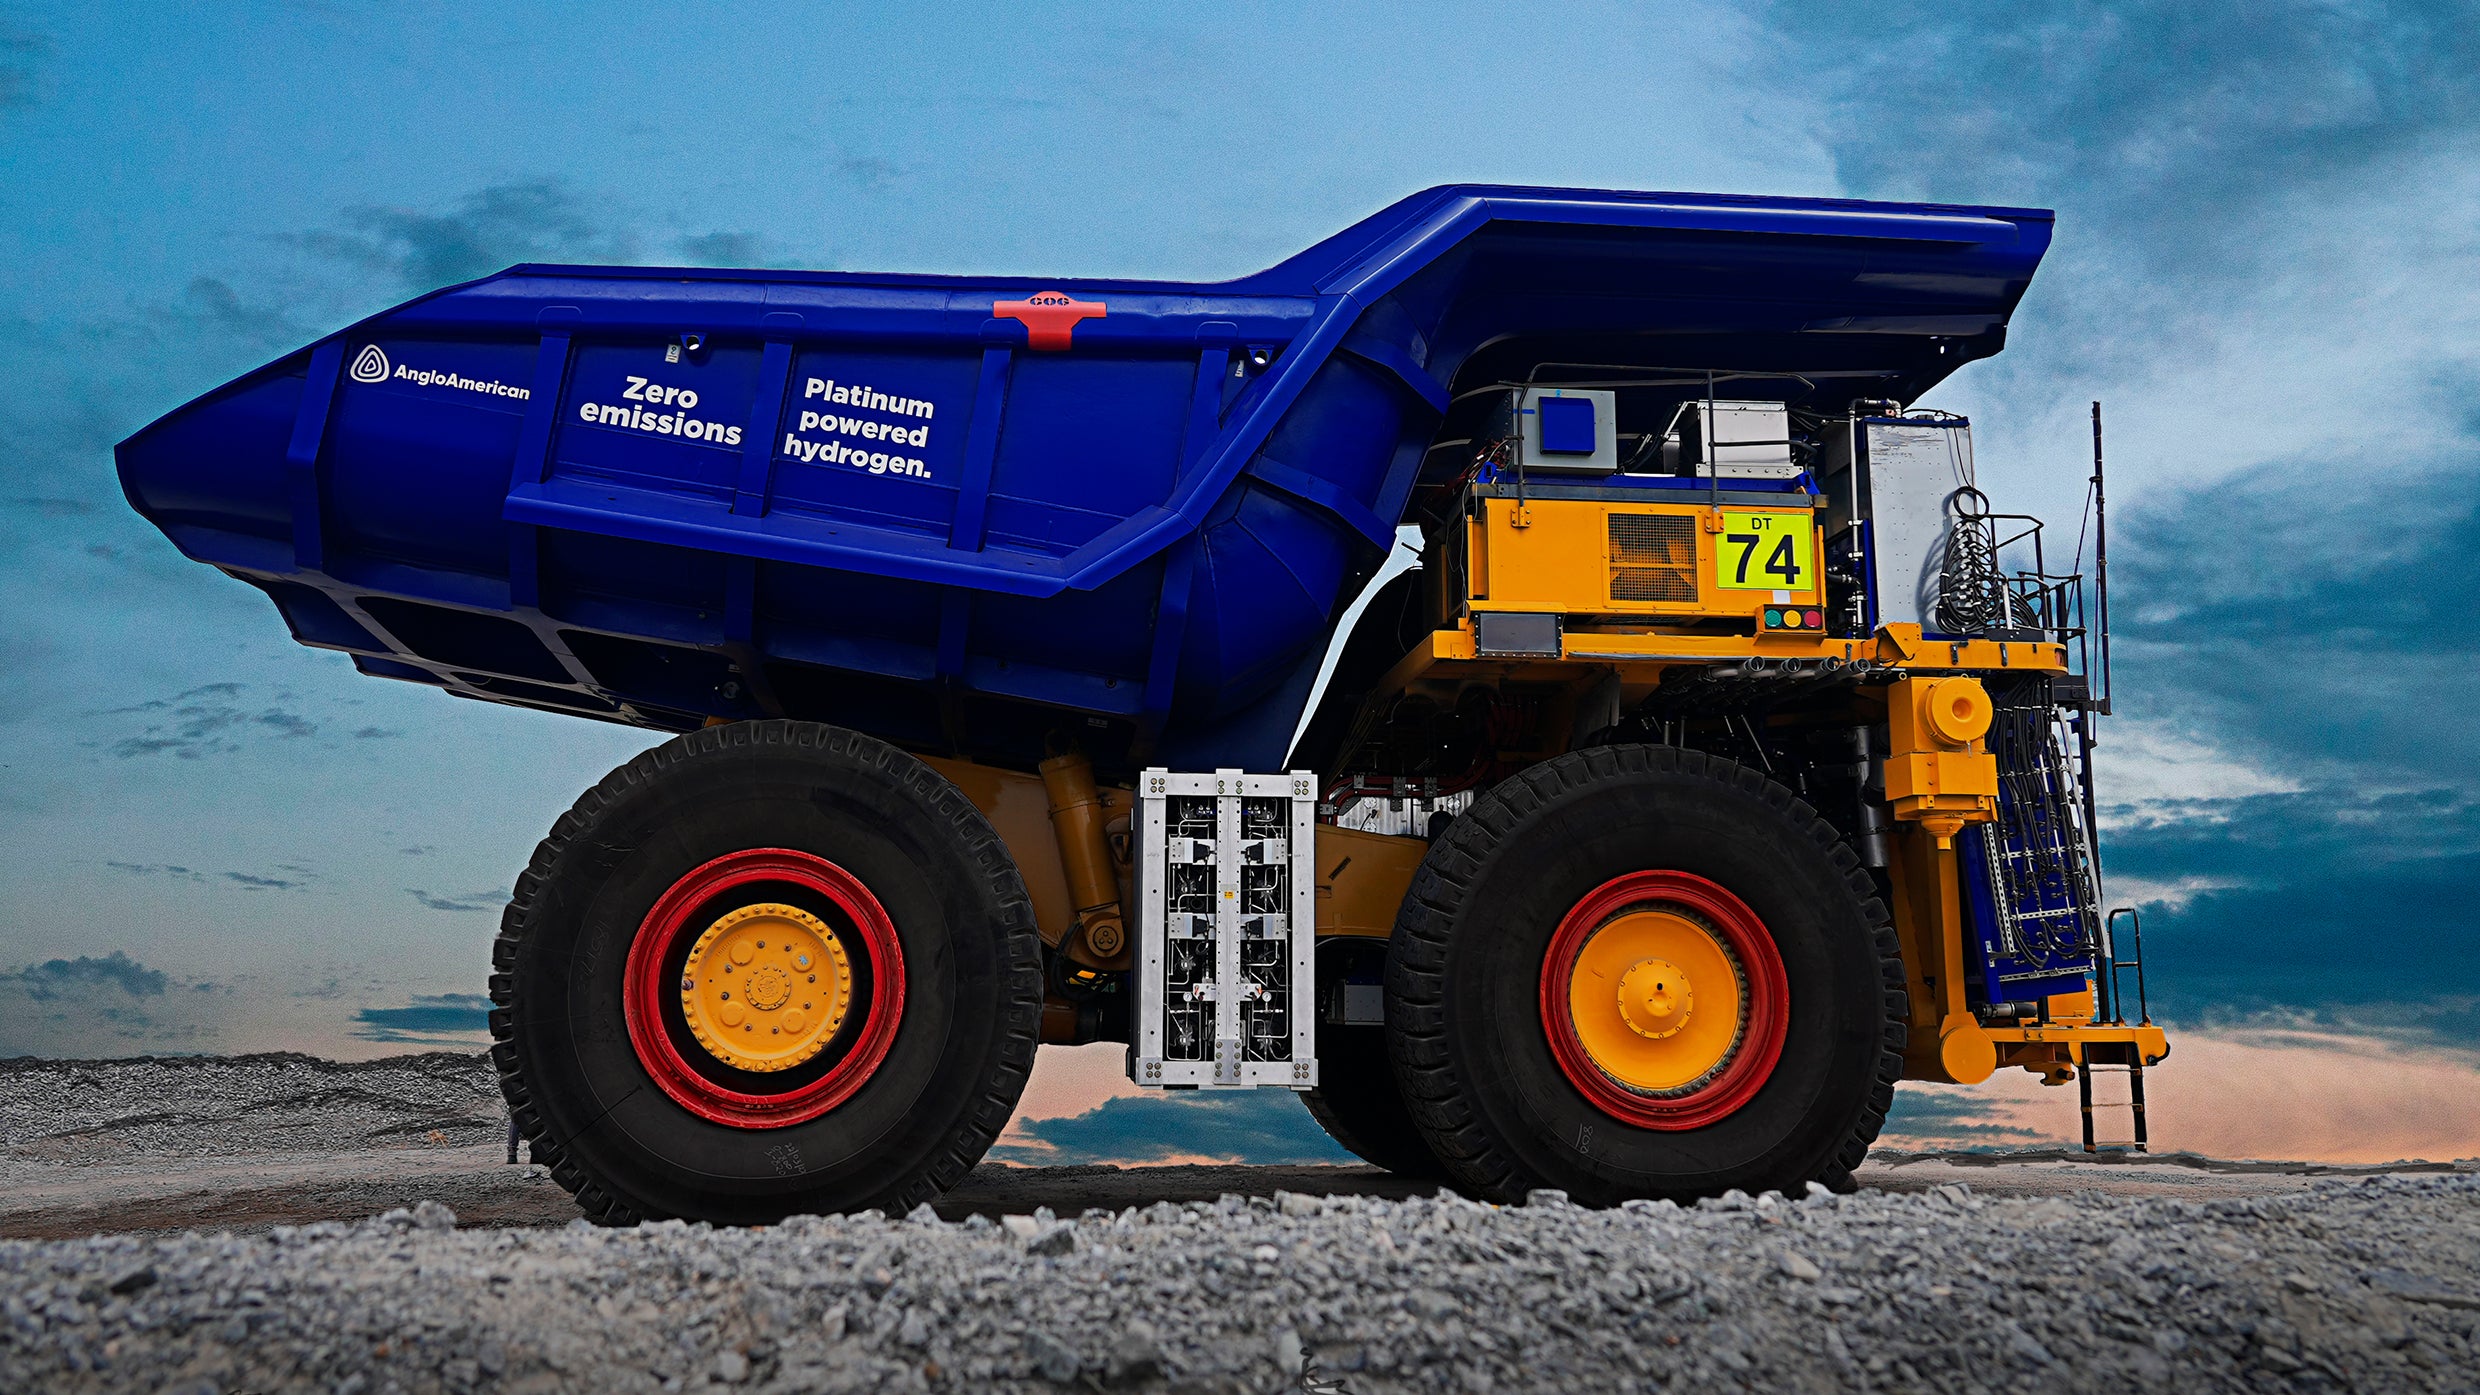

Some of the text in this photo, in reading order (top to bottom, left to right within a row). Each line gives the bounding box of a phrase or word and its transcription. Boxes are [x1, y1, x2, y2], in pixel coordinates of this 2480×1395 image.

[393, 364, 531, 400] AngloAmerican
[622, 375, 699, 409] Zero
[804, 377, 934, 419] Platinum
[579, 402, 742, 445] emissions
[799, 410, 929, 448] powered
[783, 433, 931, 478] hydrogen.
[1751, 517, 1773, 530] DT
[1727, 533, 1801, 585] 74
